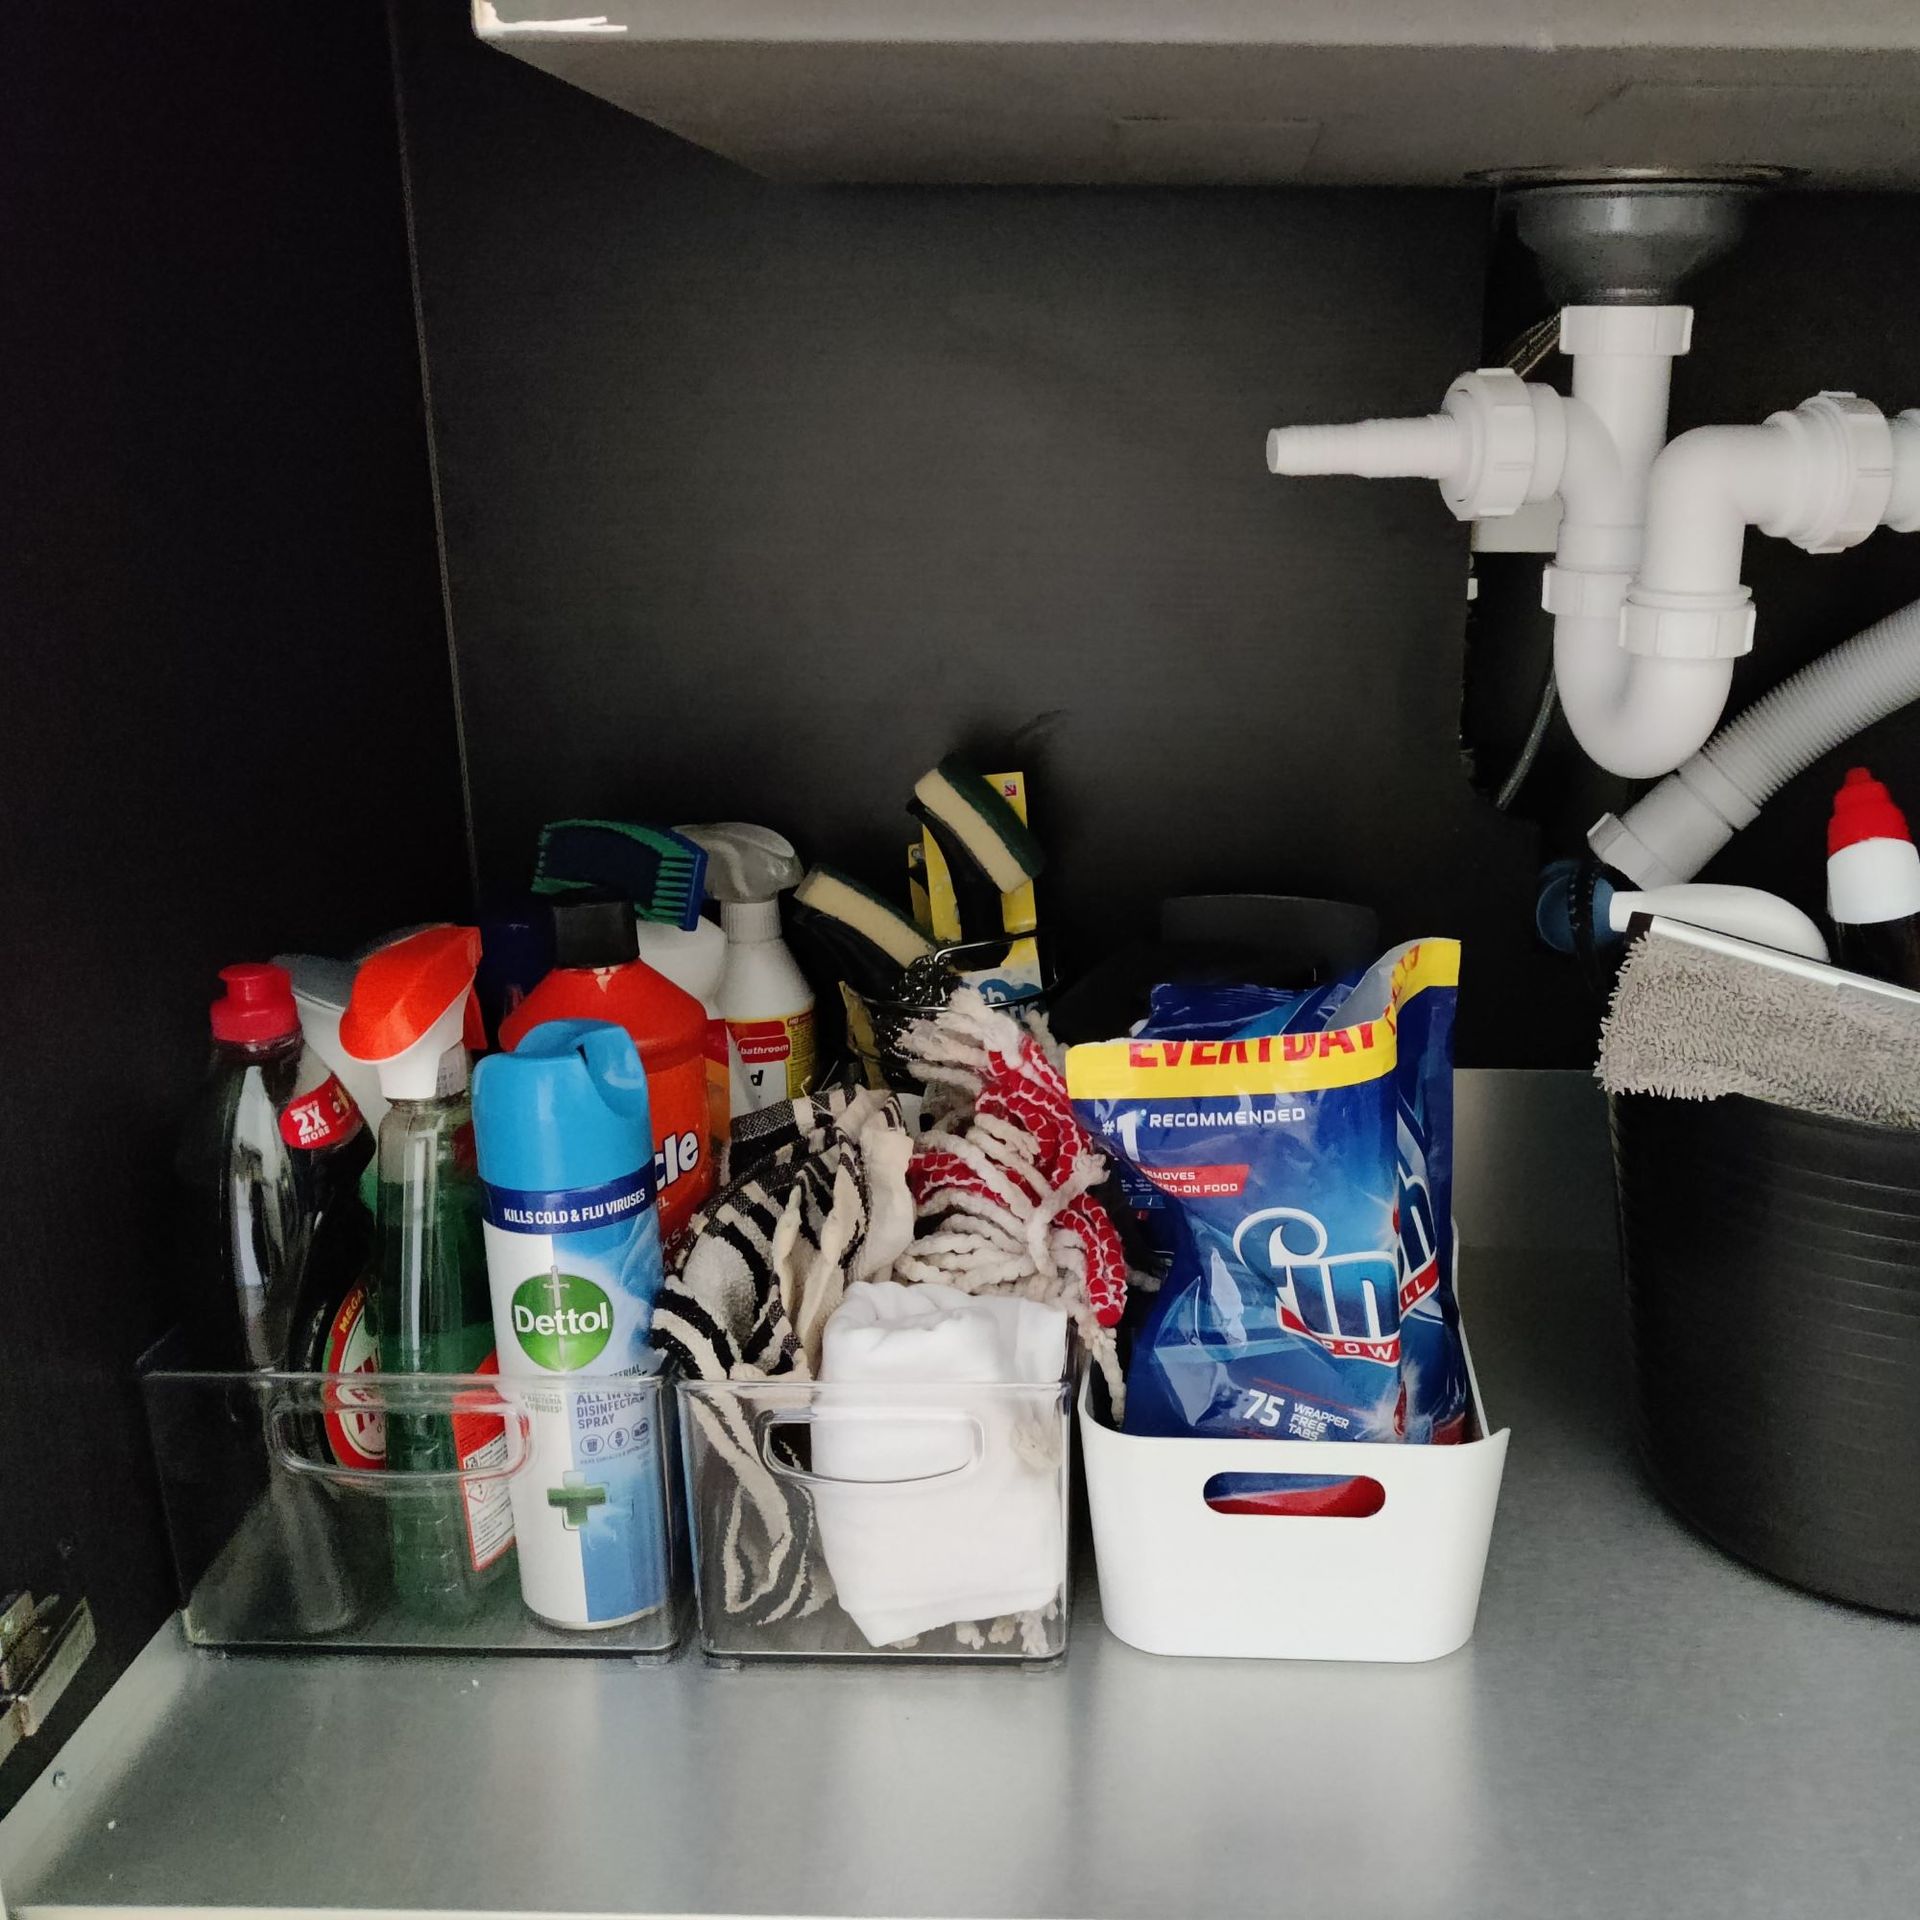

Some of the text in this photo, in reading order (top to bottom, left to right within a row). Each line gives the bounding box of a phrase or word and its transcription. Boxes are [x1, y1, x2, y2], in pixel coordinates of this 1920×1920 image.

[740, 1044, 789, 1055] bathroom
[1129, 1022, 1374, 1068] EVERYDAY
[292, 1105, 327, 1137] 2X
[1150, 1107, 1306, 1128] RECOMMENDED
[300, 1125, 331, 1146] MORE
[1102, 1110, 1141, 1162] #1
[655, 1131, 699, 1193] cle
[1140, 1168, 1196, 1181] EMOVES
[1204, 1183, 1239, 1194] FOOD
[503, 1187, 646, 1225] KILLS COLD & FLU VIRUSES
[657, 1196, 670, 1211] EL
[338, 1289, 364, 1333] MEGA
[514, 1302, 609, 1336] Dettol
[1321, 1338, 1394, 1362] POW
[1242, 1388, 1286, 1428] 75
[1293, 1402, 1350, 1430] WRAPPER
[578, 1413, 615, 1430] SPRAY
[1288, 1423, 1319, 1441] TABS
[1290, 1413, 1328, 1433] FREE
